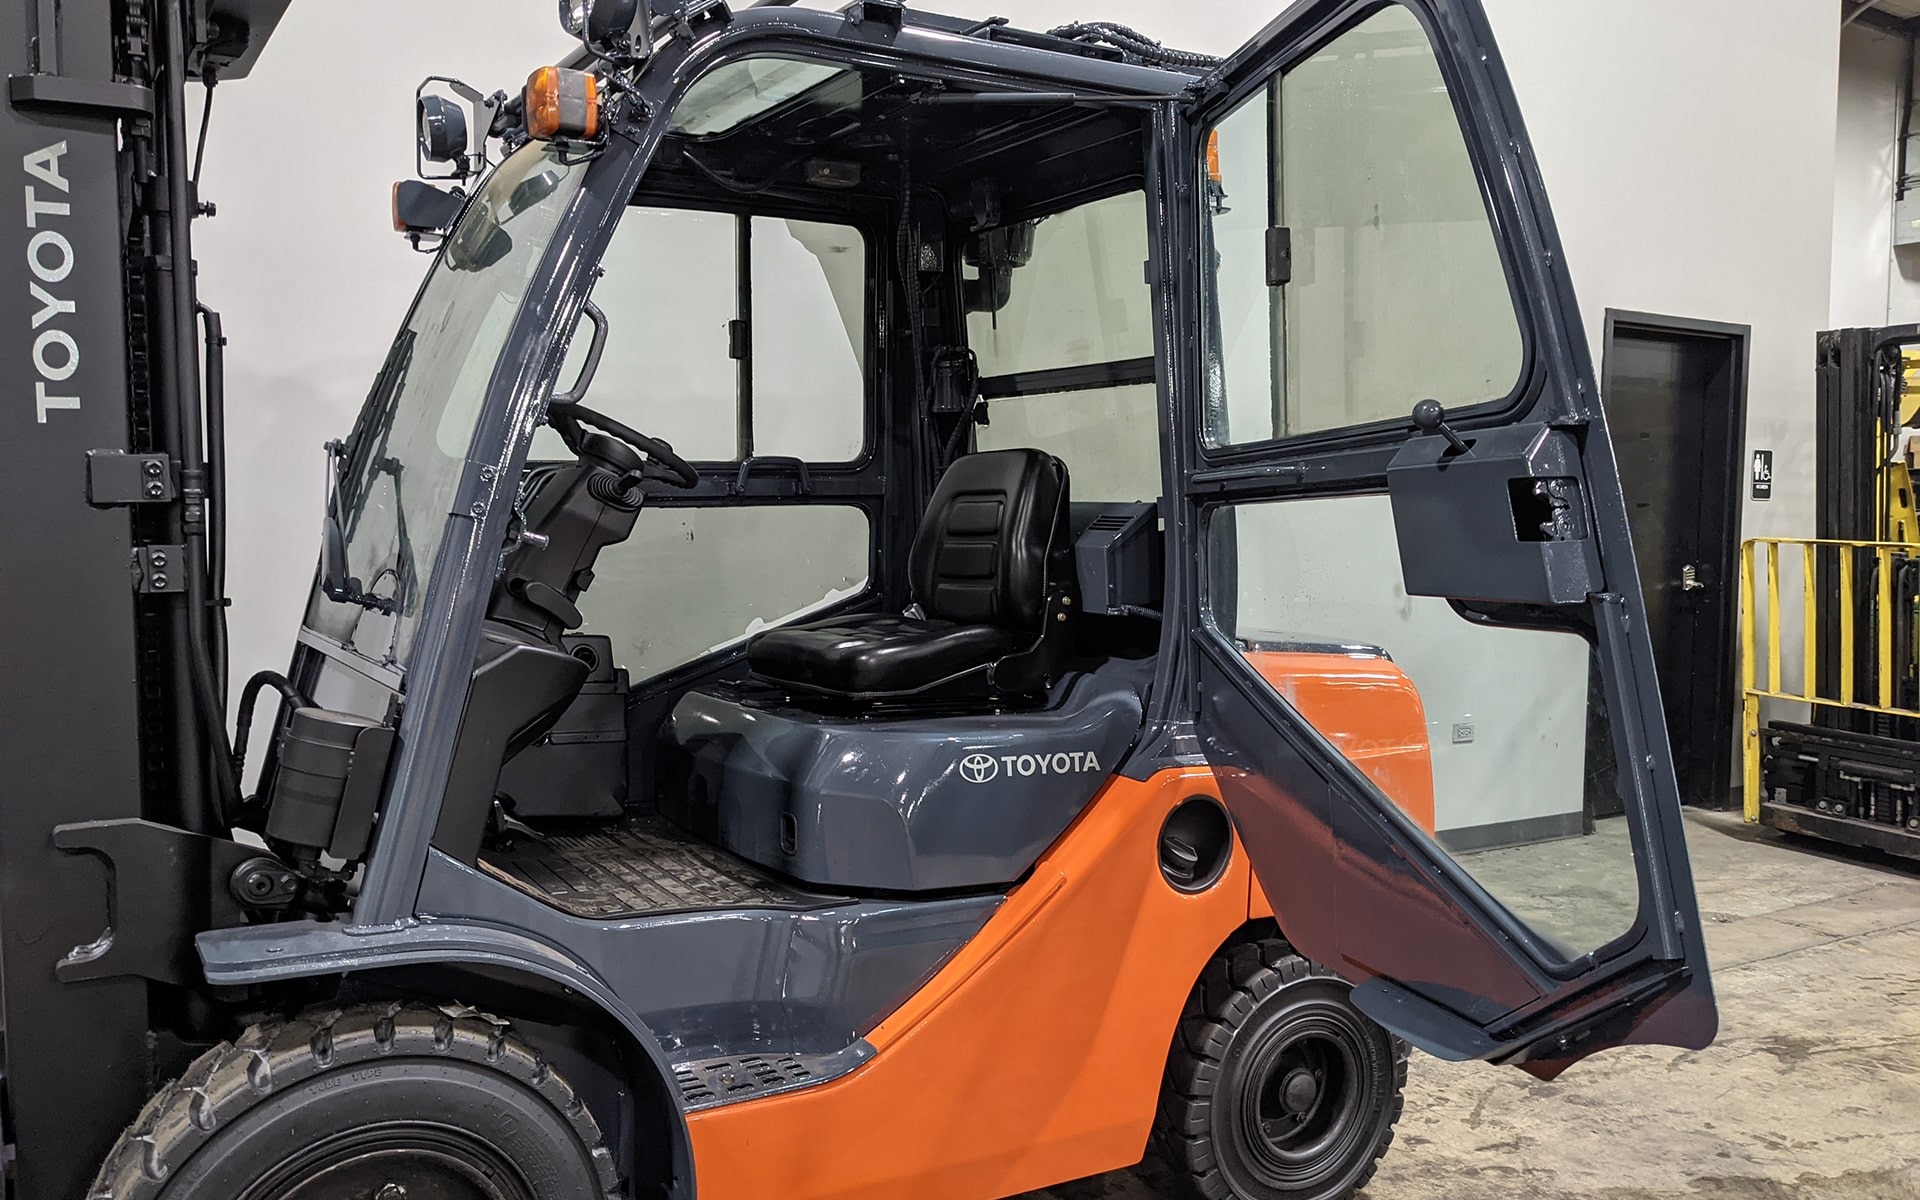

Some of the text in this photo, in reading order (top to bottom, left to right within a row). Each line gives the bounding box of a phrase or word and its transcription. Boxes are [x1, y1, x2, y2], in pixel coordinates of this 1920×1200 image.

[23, 140, 81, 423] TOYOTA
[1001, 751, 1101, 777] TOYOTA
[309, 1068, 382, 1094] TUBE TYPE
